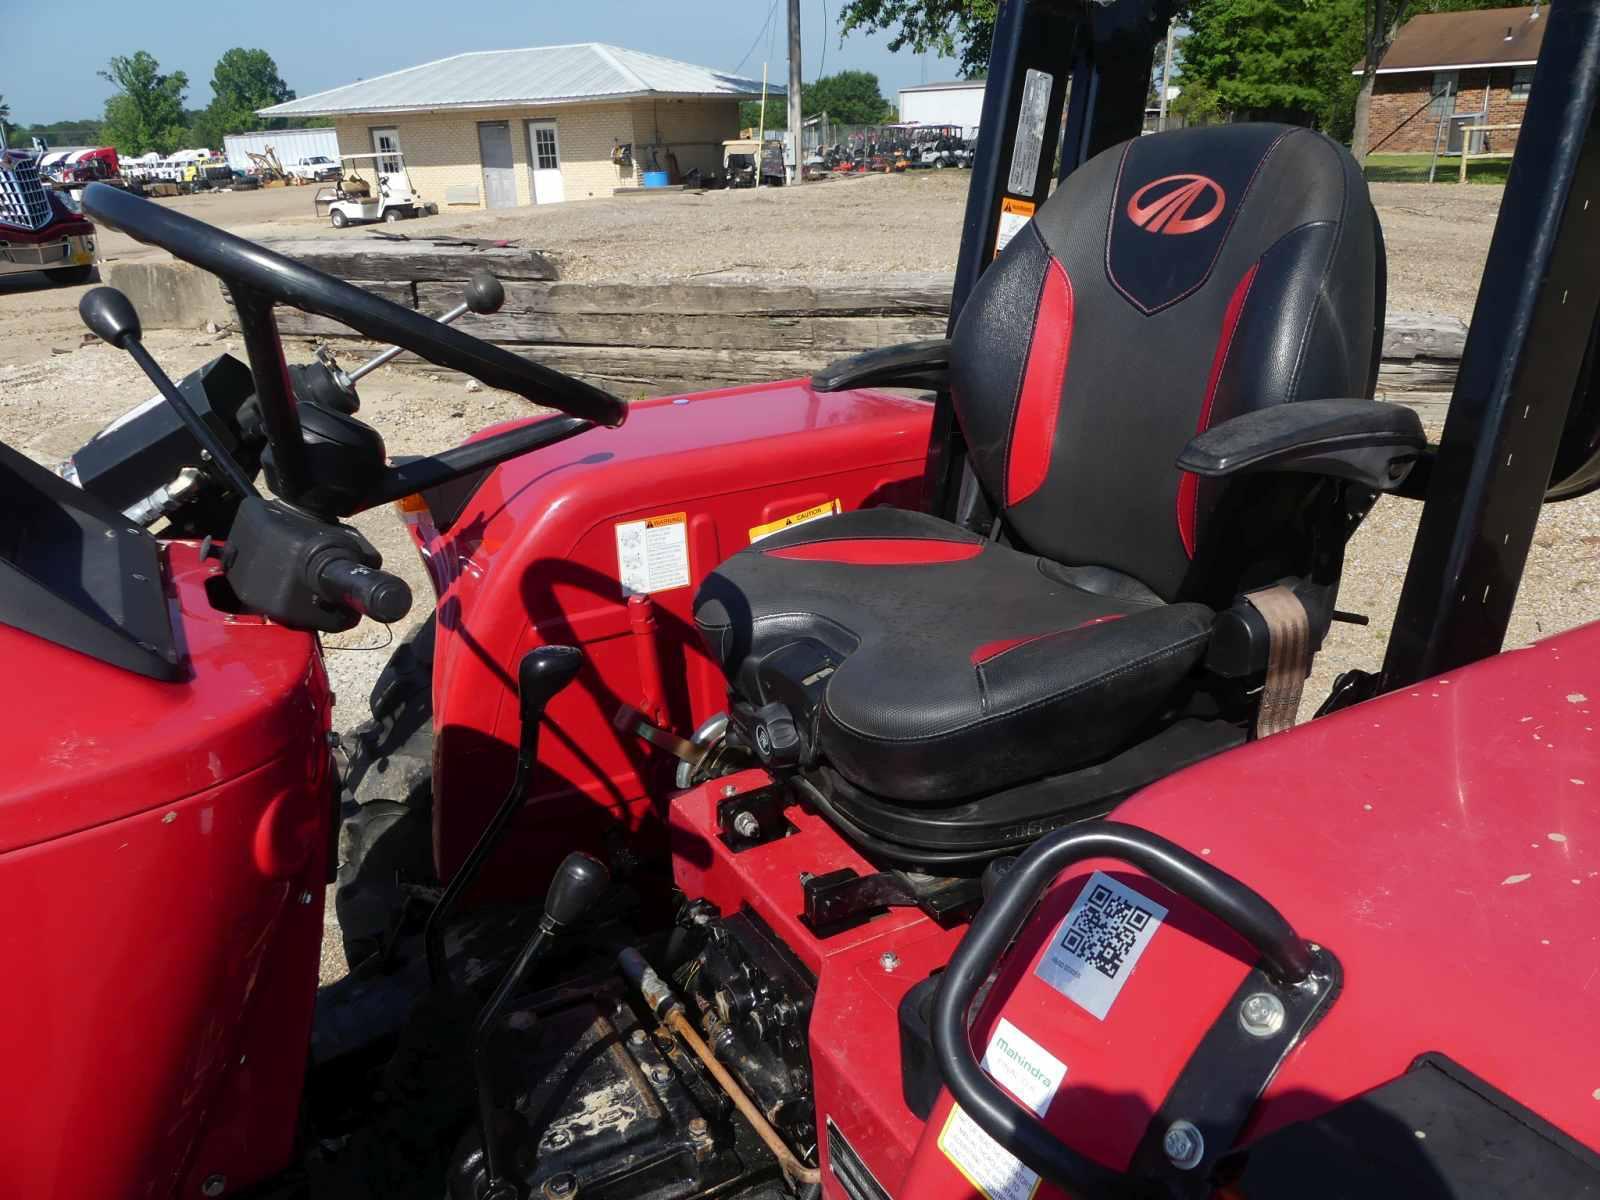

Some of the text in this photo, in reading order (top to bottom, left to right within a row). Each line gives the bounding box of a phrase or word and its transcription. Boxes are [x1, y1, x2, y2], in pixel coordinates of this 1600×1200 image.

[654, 514, 683, 527] WARNING
[796, 507, 822, 521] CAUTION
[996, 1037, 1052, 1088] mahindra
